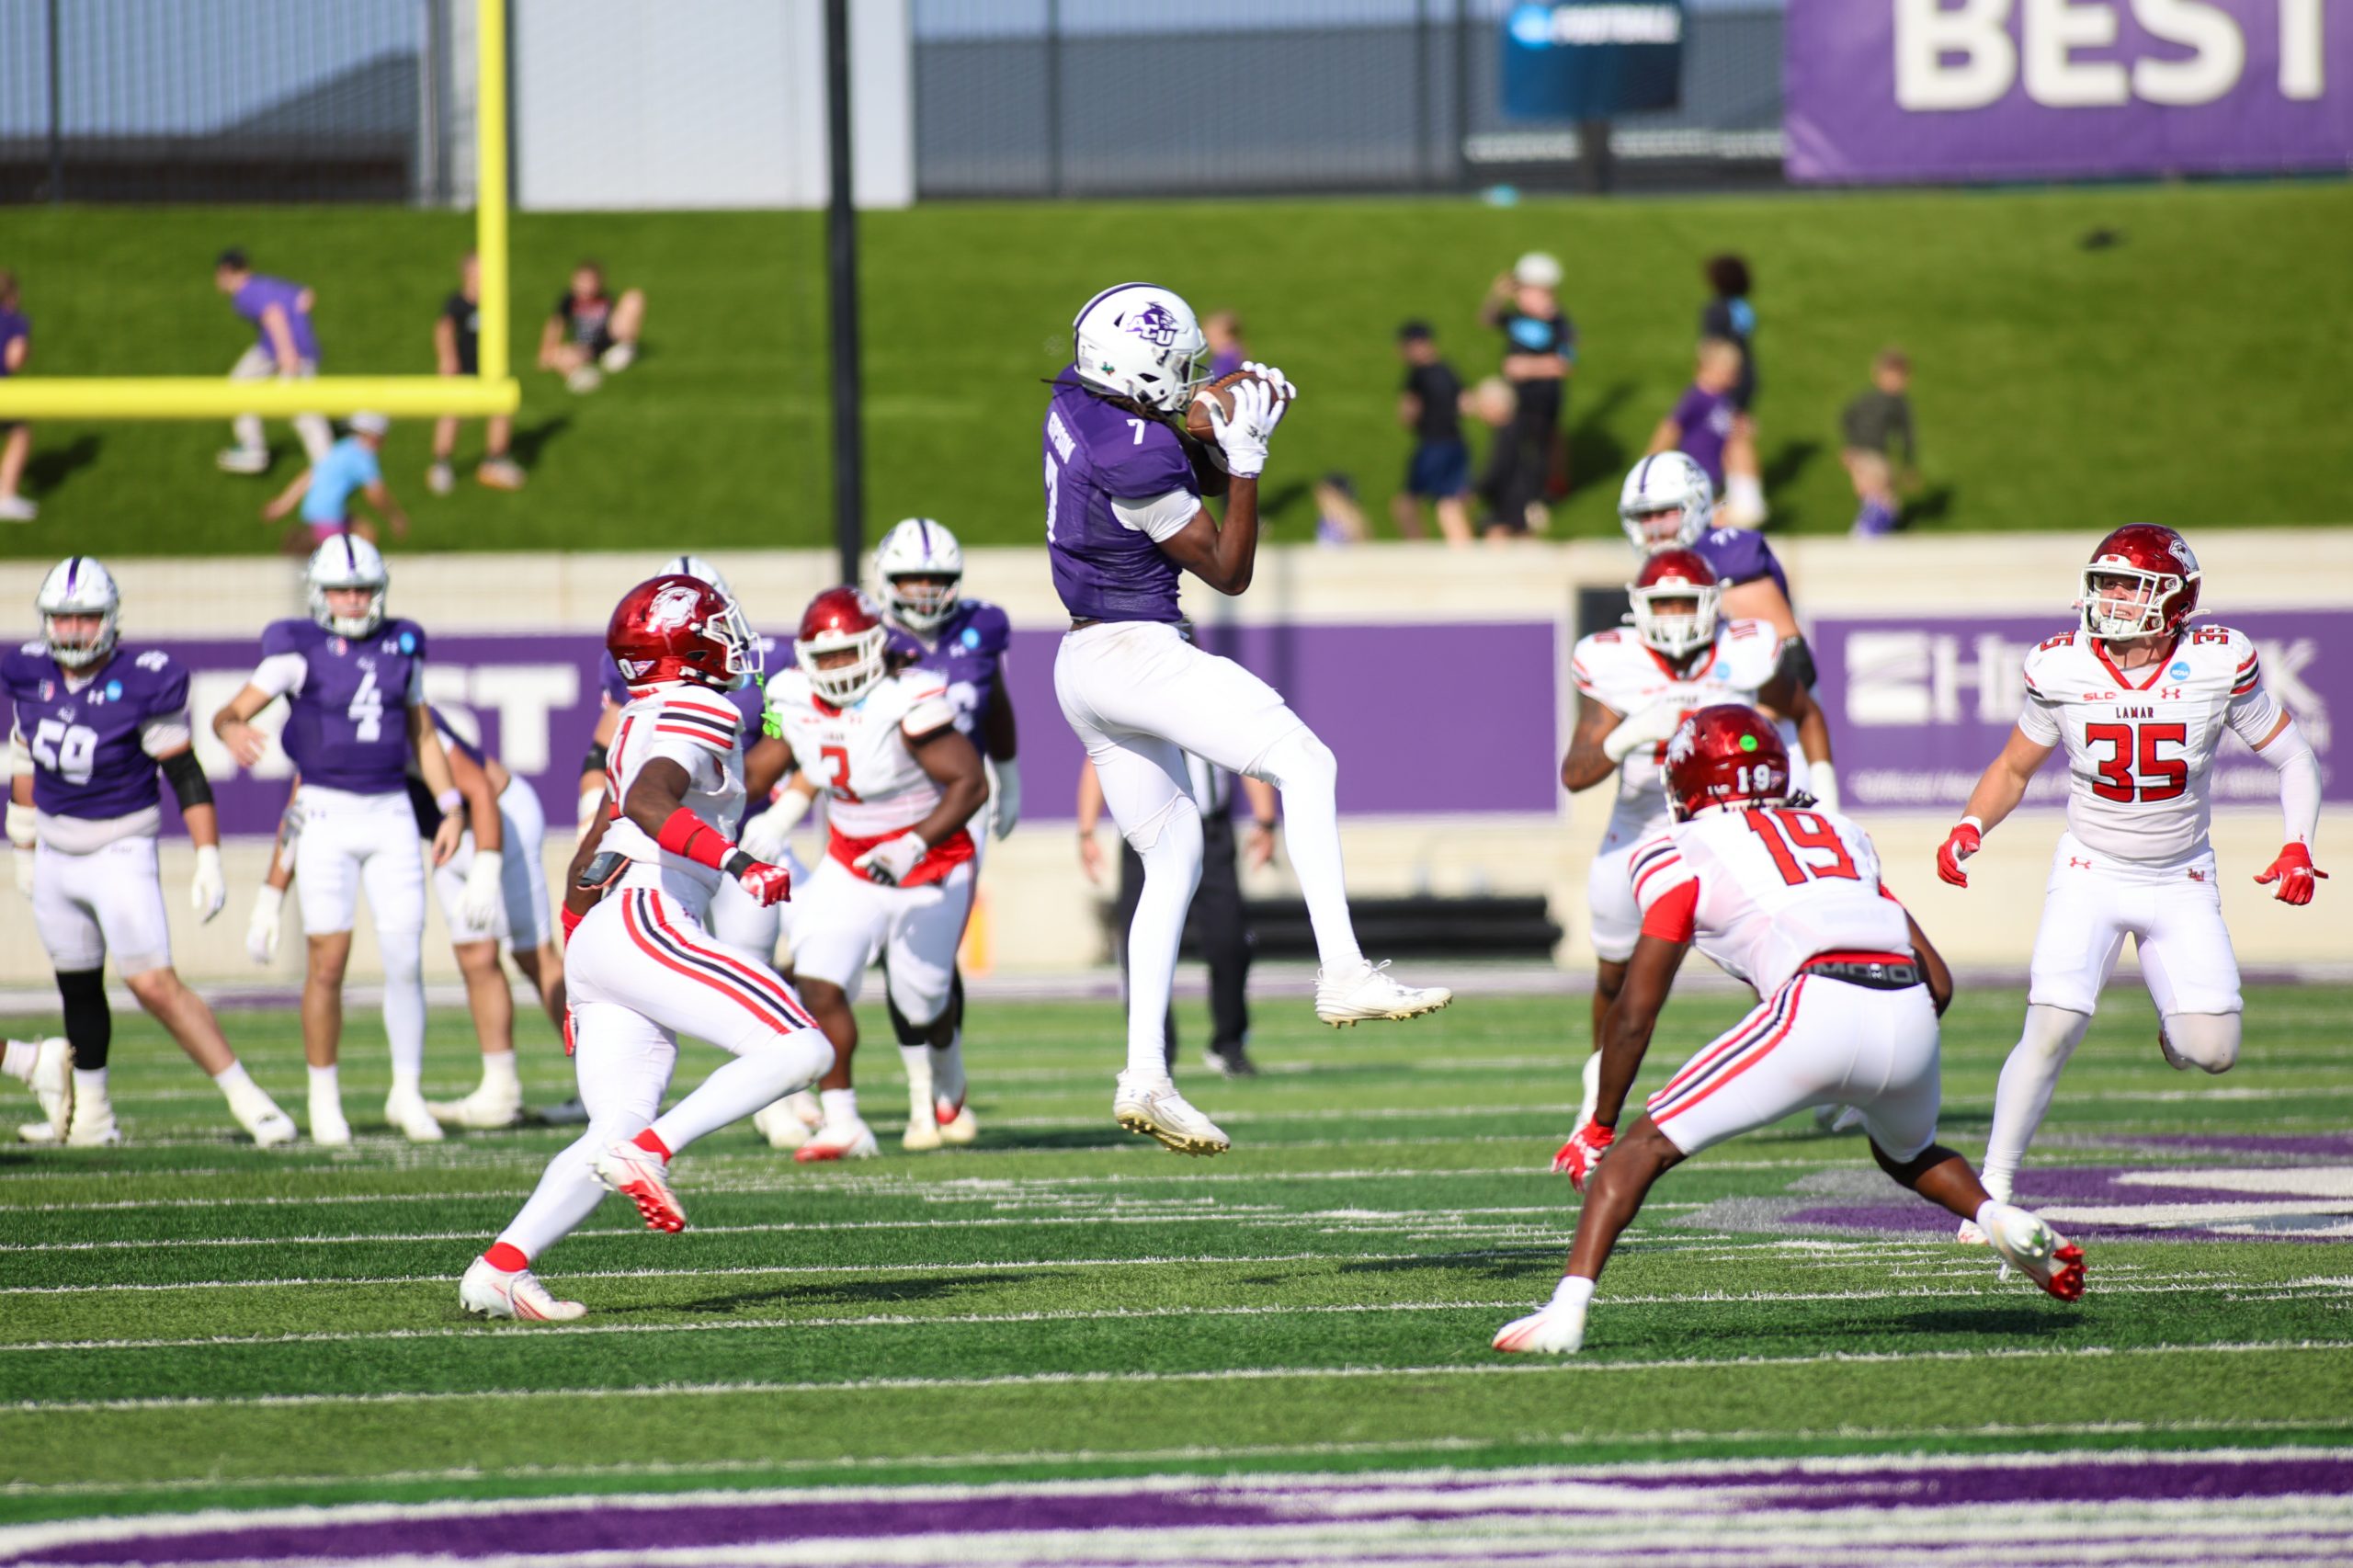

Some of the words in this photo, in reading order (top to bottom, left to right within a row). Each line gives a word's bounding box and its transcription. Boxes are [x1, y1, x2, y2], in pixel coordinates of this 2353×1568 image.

[1127, 418, 1145, 446] 7
[347, 669, 384, 743] 4
[2116, 706, 2154, 719] LAMAR
[821, 744, 865, 805] 3
[1736, 764, 1771, 794] 19
[2086, 722, 2188, 803] 35
[1740, 806, 1862, 886] 19
